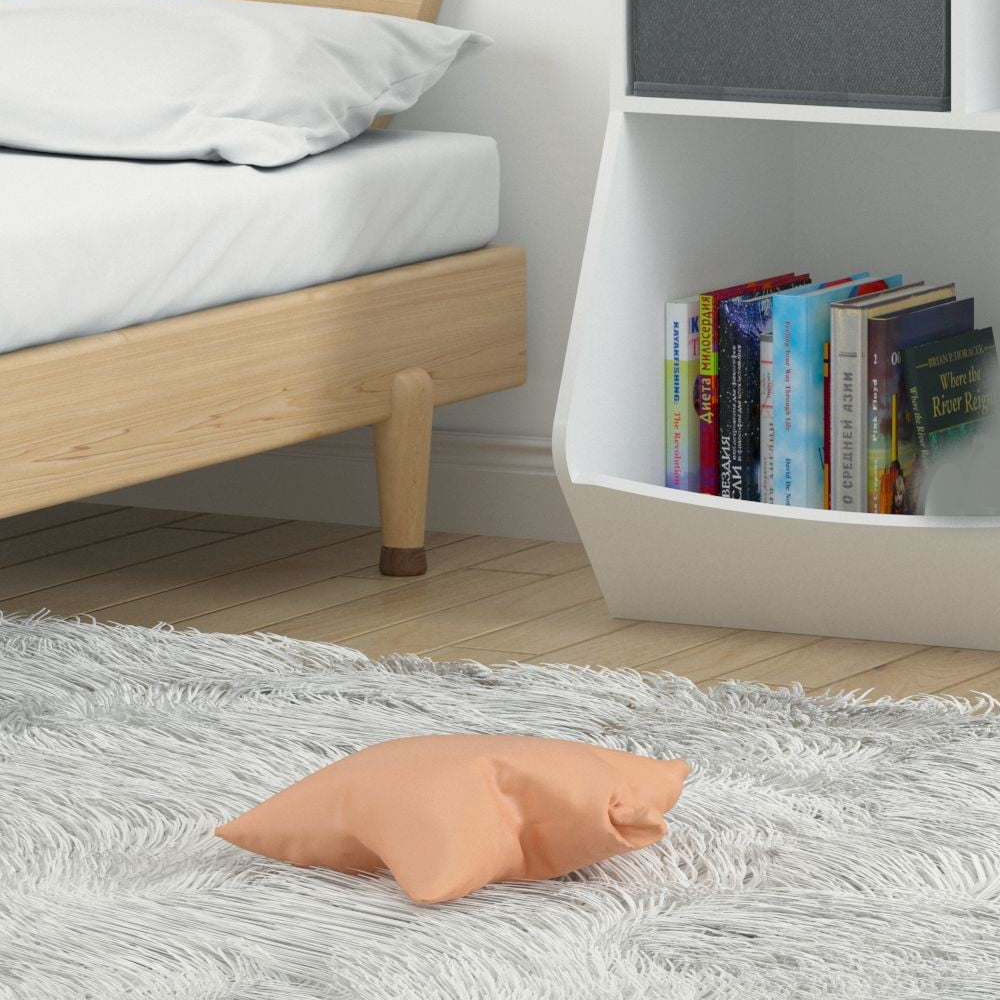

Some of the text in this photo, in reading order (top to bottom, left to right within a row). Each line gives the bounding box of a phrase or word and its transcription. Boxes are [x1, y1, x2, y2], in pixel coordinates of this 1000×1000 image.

[699, 296, 712, 424] Диета милосердия
[927, 352, 949, 368] BRIAN
[939, 366, 981, 391] Where the
[909, 386, 920, 412] Where
[932, 394, 962, 418] River
[913, 412, 923, 424] the
[672, 411, 681, 486] The Revolution
[840, 371, 853, 505] О СРЕДНЕЙ АЗИИ
[917, 425, 926, 448] River
[785, 481, 791, 491] De
